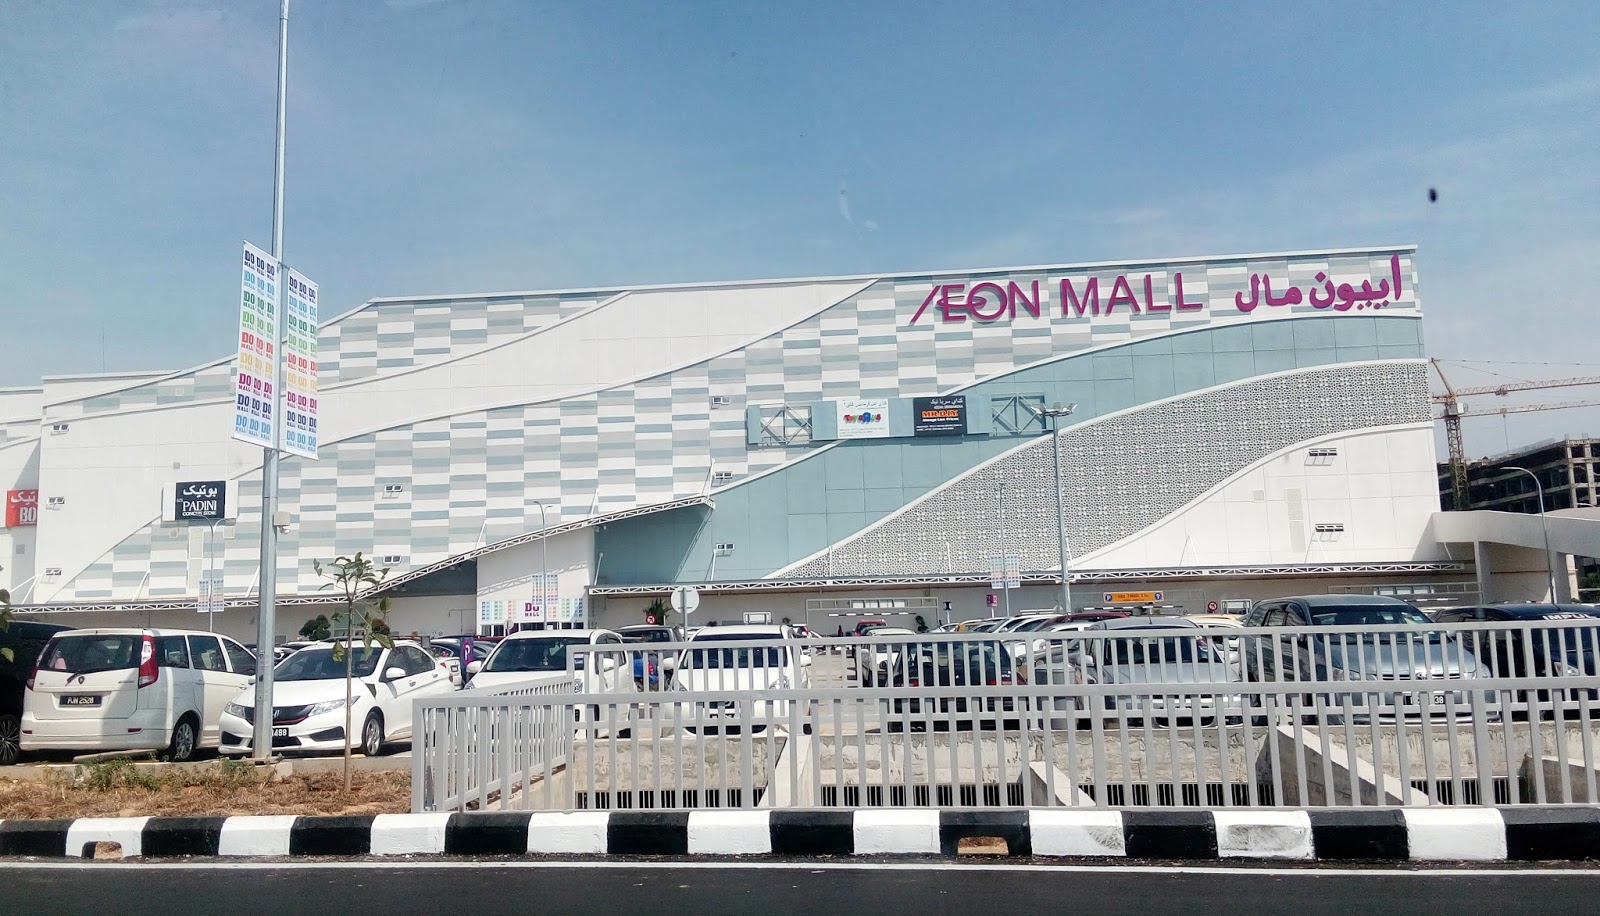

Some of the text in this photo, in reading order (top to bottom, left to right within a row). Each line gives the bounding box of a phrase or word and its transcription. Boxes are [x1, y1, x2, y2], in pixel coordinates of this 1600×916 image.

[245, 250, 274, 276] DO DO DO
[290, 276, 315, 299] DO DO DO
[1061, 273, 1203, 317] MALL
[1235, 273, 1302, 312] مال
[244, 291, 254, 304] DO
[289, 314, 296, 326] DO
[299, 320, 307, 331] DO
[242, 332, 253, 345] DO
[288, 352, 296, 364] DO
[299, 357, 307, 369] DO
[239, 373, 251, 386] DO
[254, 378, 261, 390] DO
[264, 382, 272, 394] DO
[238, 394, 271, 414] DO DO DO
[288, 391, 317, 409] DO DO DO
[236, 414, 270, 434] DO DO DO
[287, 411, 316, 428] DO DO DO
[287, 430, 316, 447] DO DO DO
[183, 500, 217, 511] PADINI
[465, 644, 470, 660] P
